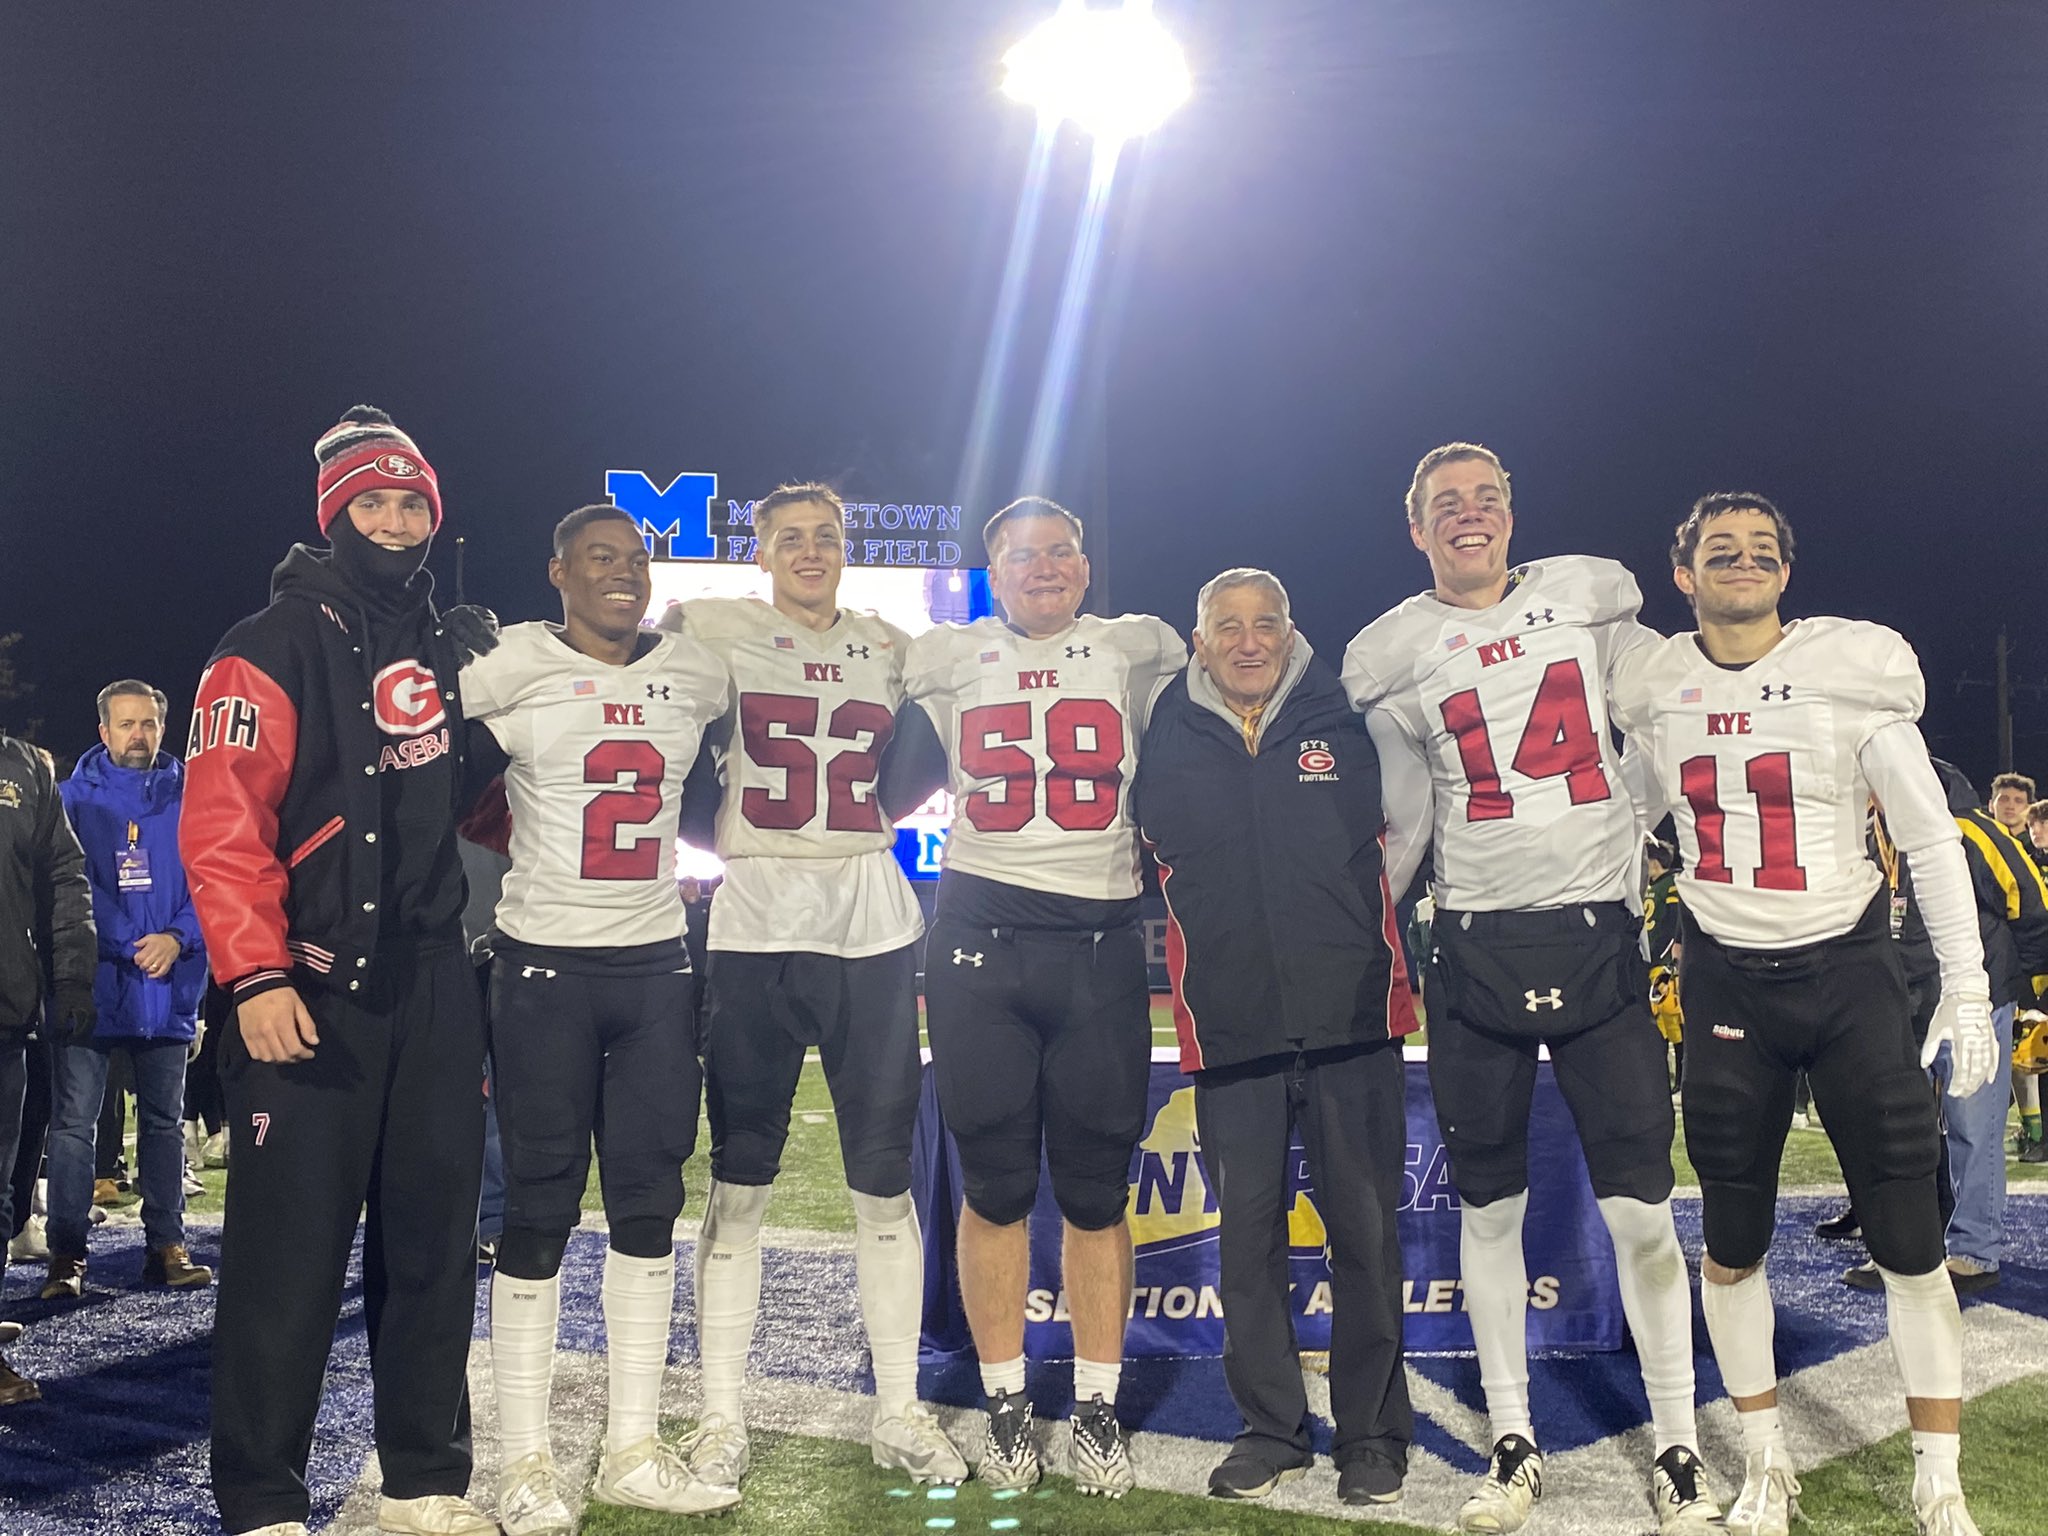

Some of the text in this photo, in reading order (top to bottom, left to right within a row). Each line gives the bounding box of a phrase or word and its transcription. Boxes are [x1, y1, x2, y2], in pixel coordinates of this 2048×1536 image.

[605, 469, 717, 560] M
[727, 499, 961, 531] METOWN
[863, 539, 961, 566] FIELD
[1476, 635, 1526, 668] RYE
[803, 662, 844, 683] RYE
[1018, 670, 1059, 690] RYE
[185, 695, 260, 762] ATH
[602, 703, 645, 725] RYE
[1707, 712, 1752, 736] RYE
[378, 728, 450, 772] ASEB
[1300, 740, 1329, 752] RYE
[1439, 657, 1612, 823] 14
[740, 692, 895, 832] 52
[959, 698, 1125, 832] 58
[1299, 773, 1340, 782] FOOTBALL
[580, 740, 665, 880] 2
[1680, 751, 1807, 891] 11
[252, 1113, 270, 1146] 7
